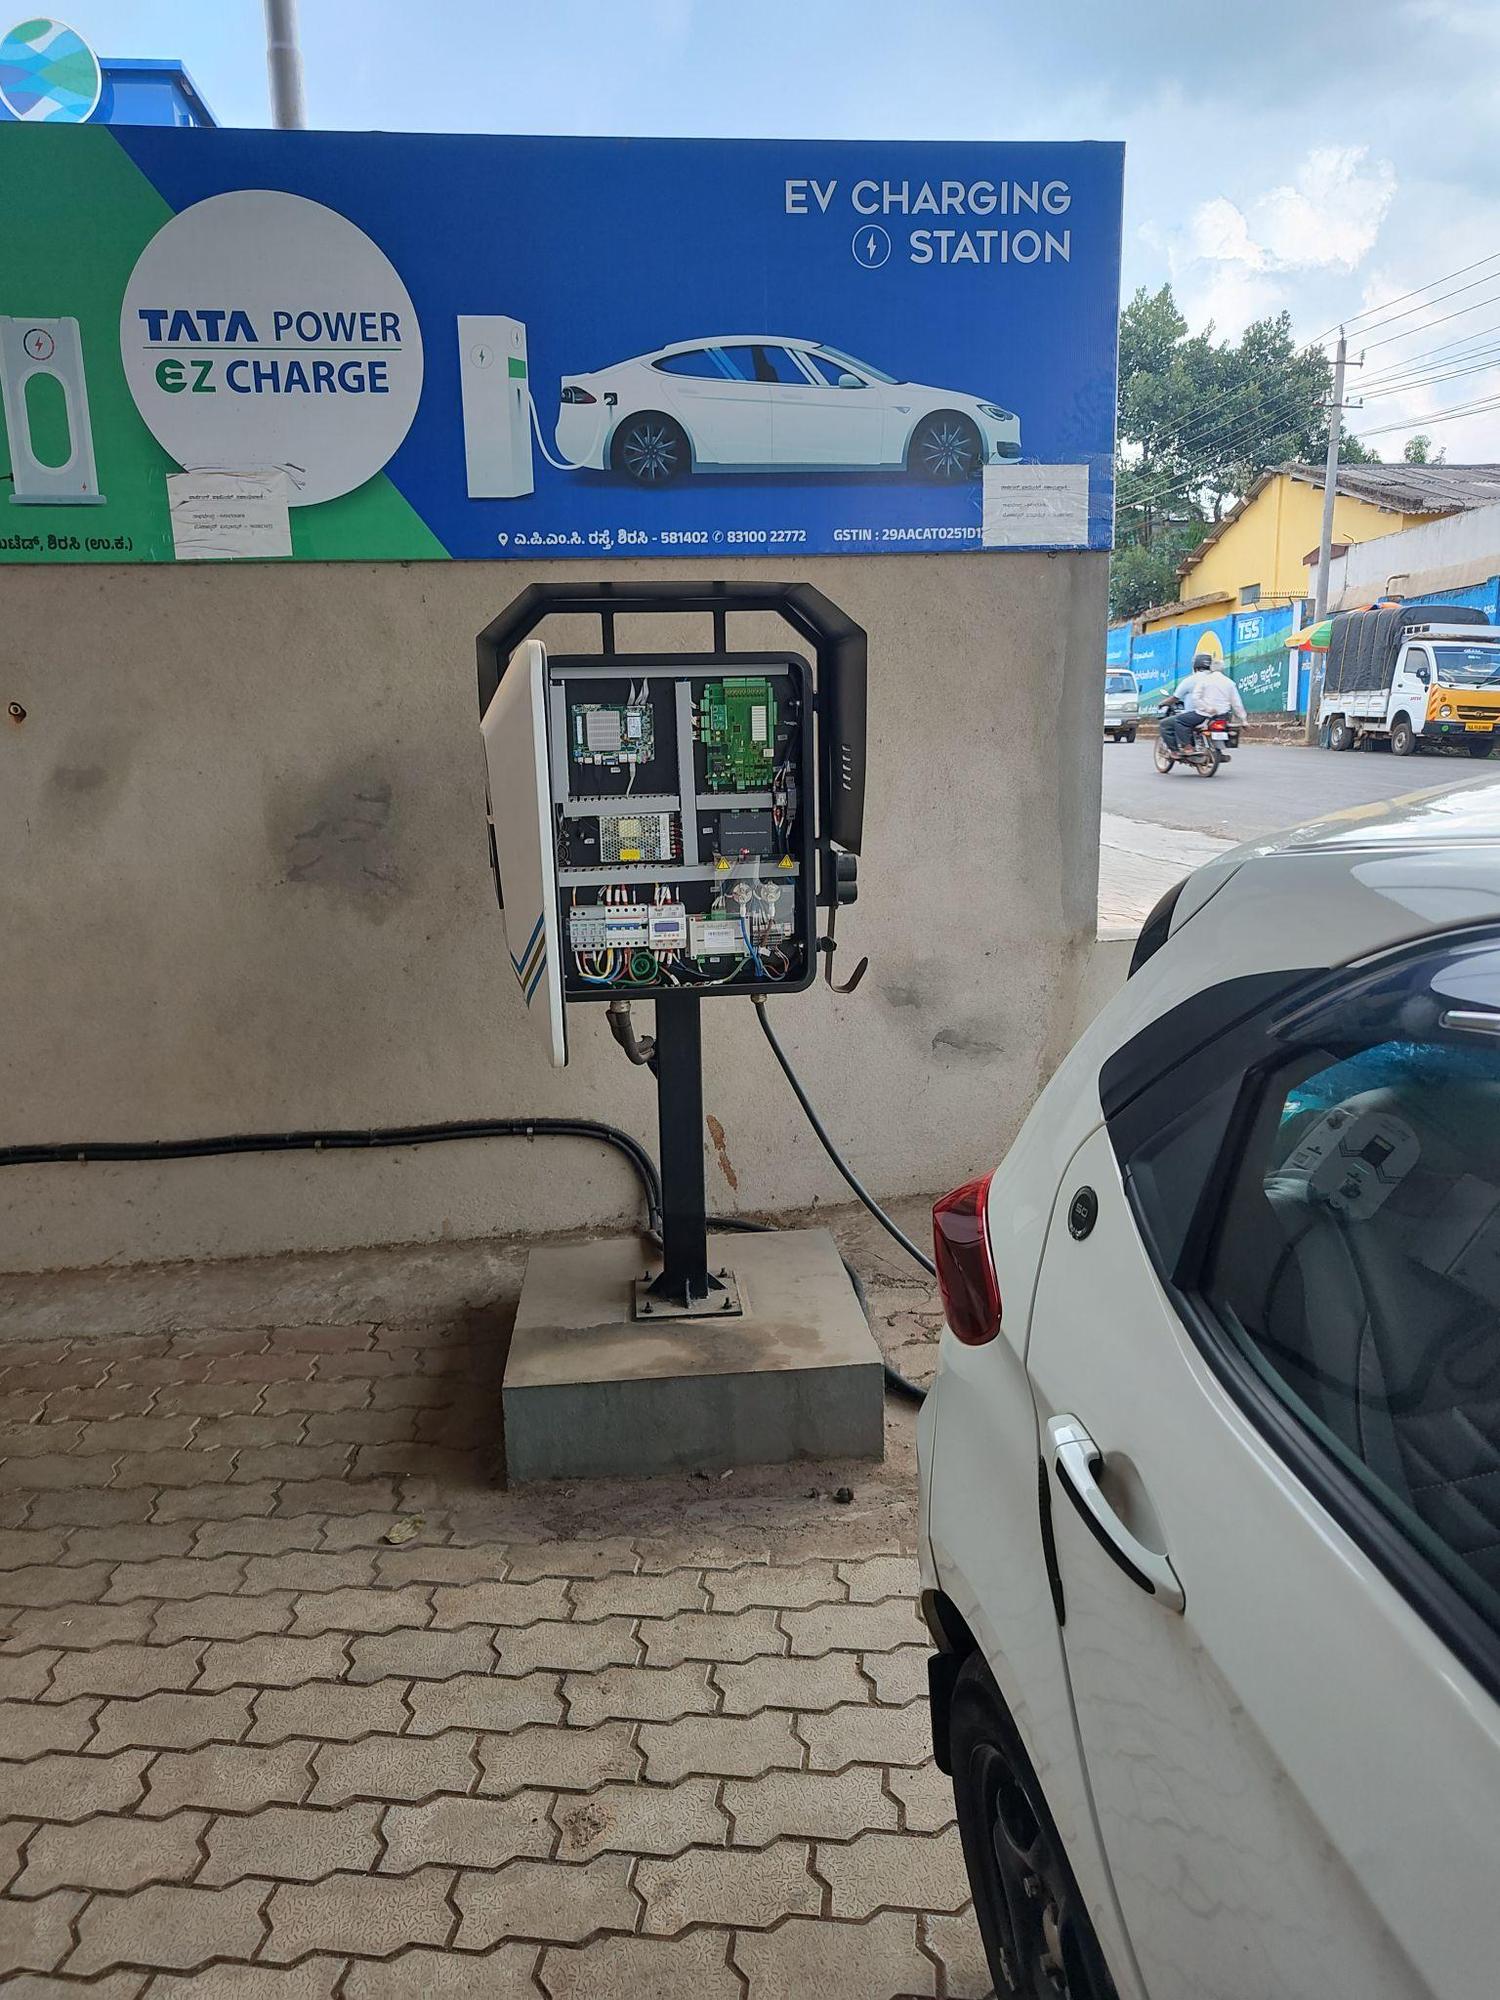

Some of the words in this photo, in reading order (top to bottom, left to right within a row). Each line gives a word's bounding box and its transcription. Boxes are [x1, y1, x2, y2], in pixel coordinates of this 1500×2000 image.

[785, 180, 838, 214] EV
[851, 180, 1072, 216] CHARGING
[909, 229, 1071, 264] STATION
[138, 309, 259, 342] TATA
[273, 311, 402, 342] POWER
[155, 358, 217, 394] EZ
[226, 360, 390, 394] CHARGE
[47, 534, 81, 550] ಶಿರಸಿ
[617, 528, 648, 545] ಶಿರಸಿ
[660, 531, 709, 544] 581402
[727, 530, 767, 543] 83100
[769, 530, 807, 543] 22772
[833, 529, 872, 541] GSTIN
[882, 527, 983, 541] 29AACAT0251D1
[1238, 619, 1261, 641] TSS
